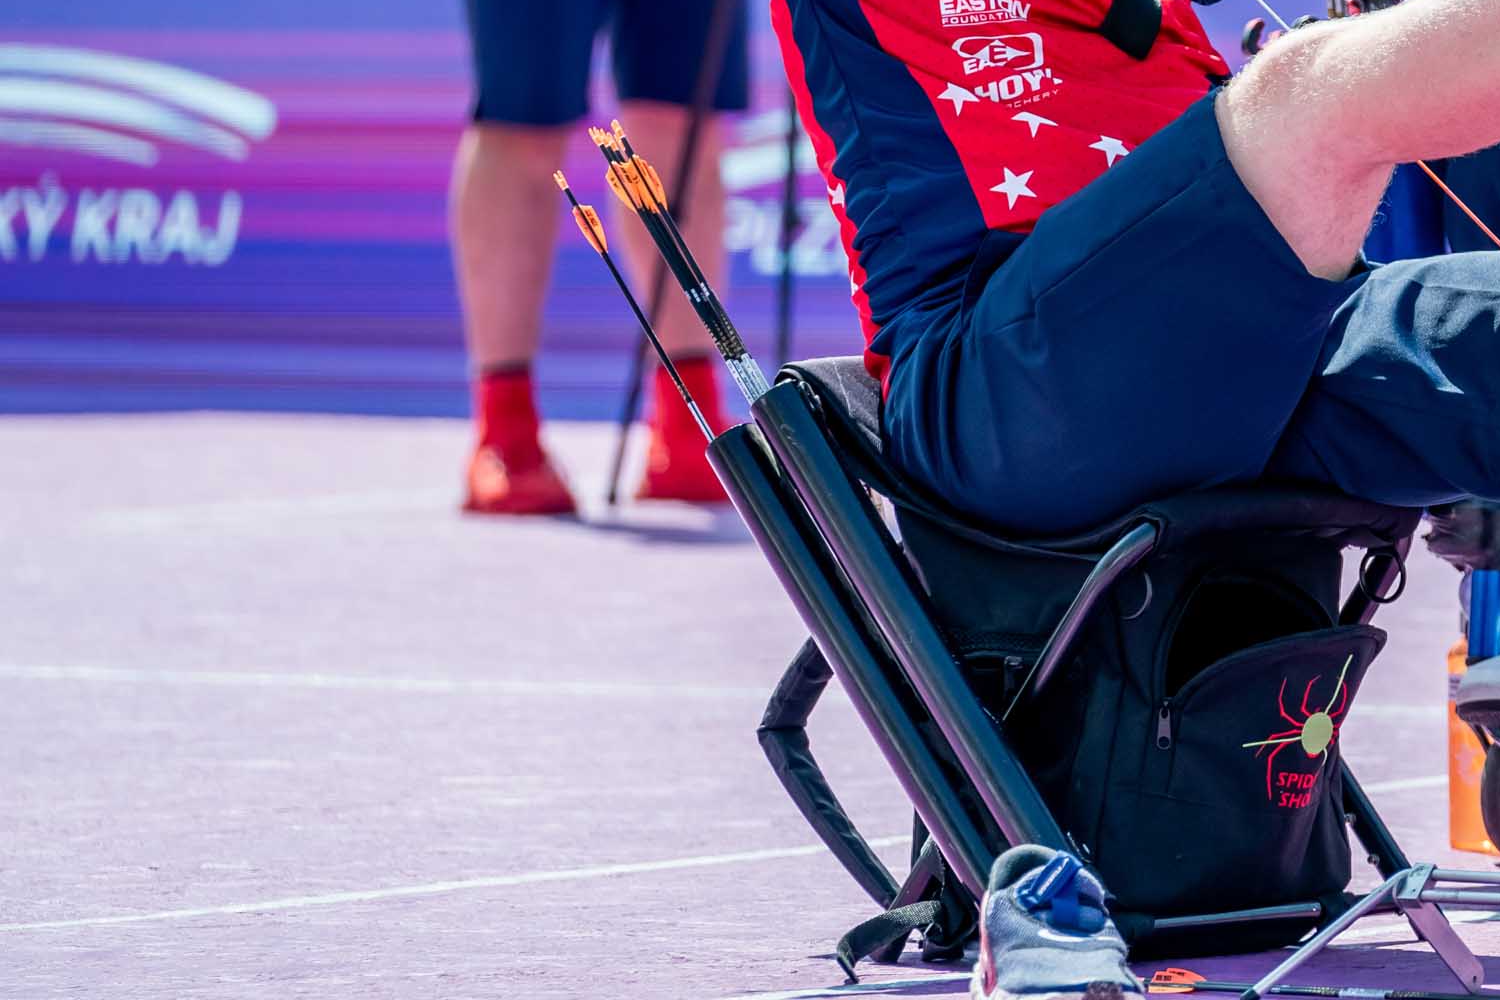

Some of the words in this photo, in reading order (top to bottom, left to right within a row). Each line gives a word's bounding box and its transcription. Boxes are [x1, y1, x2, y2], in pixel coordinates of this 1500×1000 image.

[942, 10, 1018, 25] FOUNDATI
[71, 187, 243, 267] KRAJ
[1276, 772, 1317, 789] SPID
[1278, 792, 1312, 809] SHO
